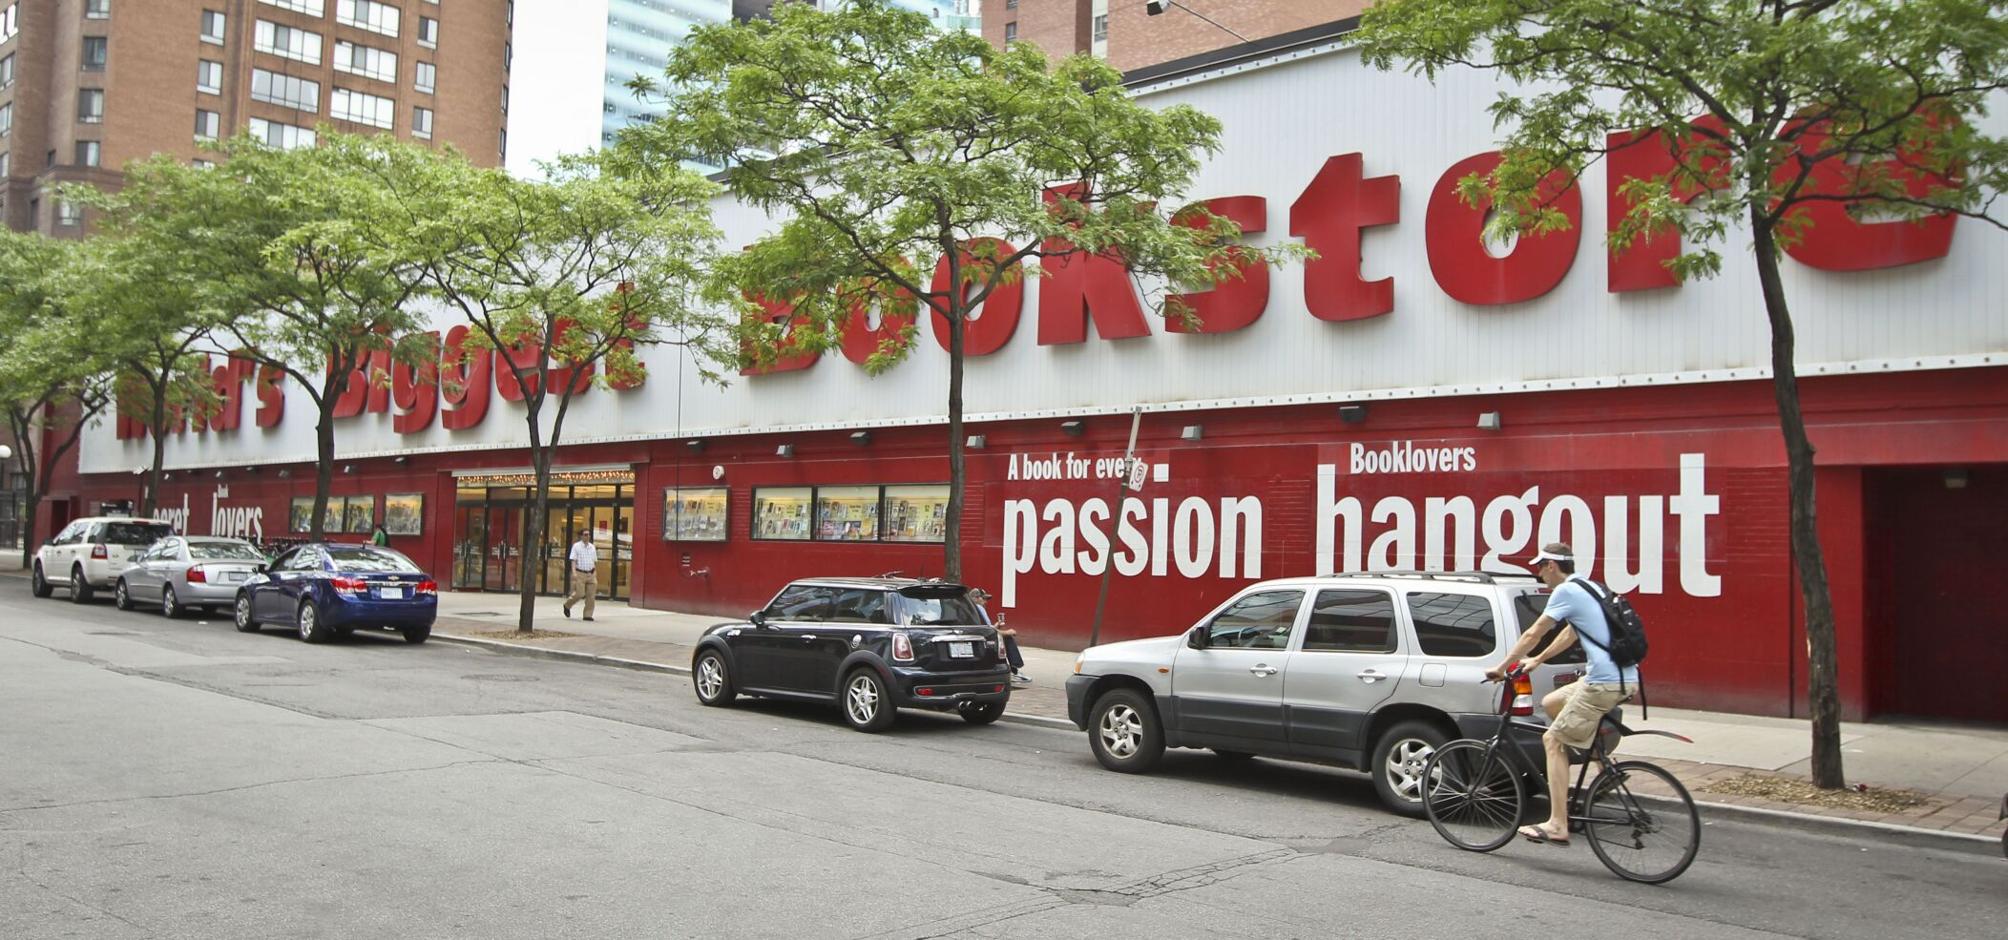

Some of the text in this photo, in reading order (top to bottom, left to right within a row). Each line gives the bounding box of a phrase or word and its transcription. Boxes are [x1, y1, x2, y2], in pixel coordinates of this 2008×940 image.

[327, 283, 646, 434] Biggest
[1008, 451, 1142, 480] A book for eve
[1317, 454, 1721, 596] hangout
[1350, 441, 1476, 473] Booklovers
[1004, 464, 1261, 607] passion
